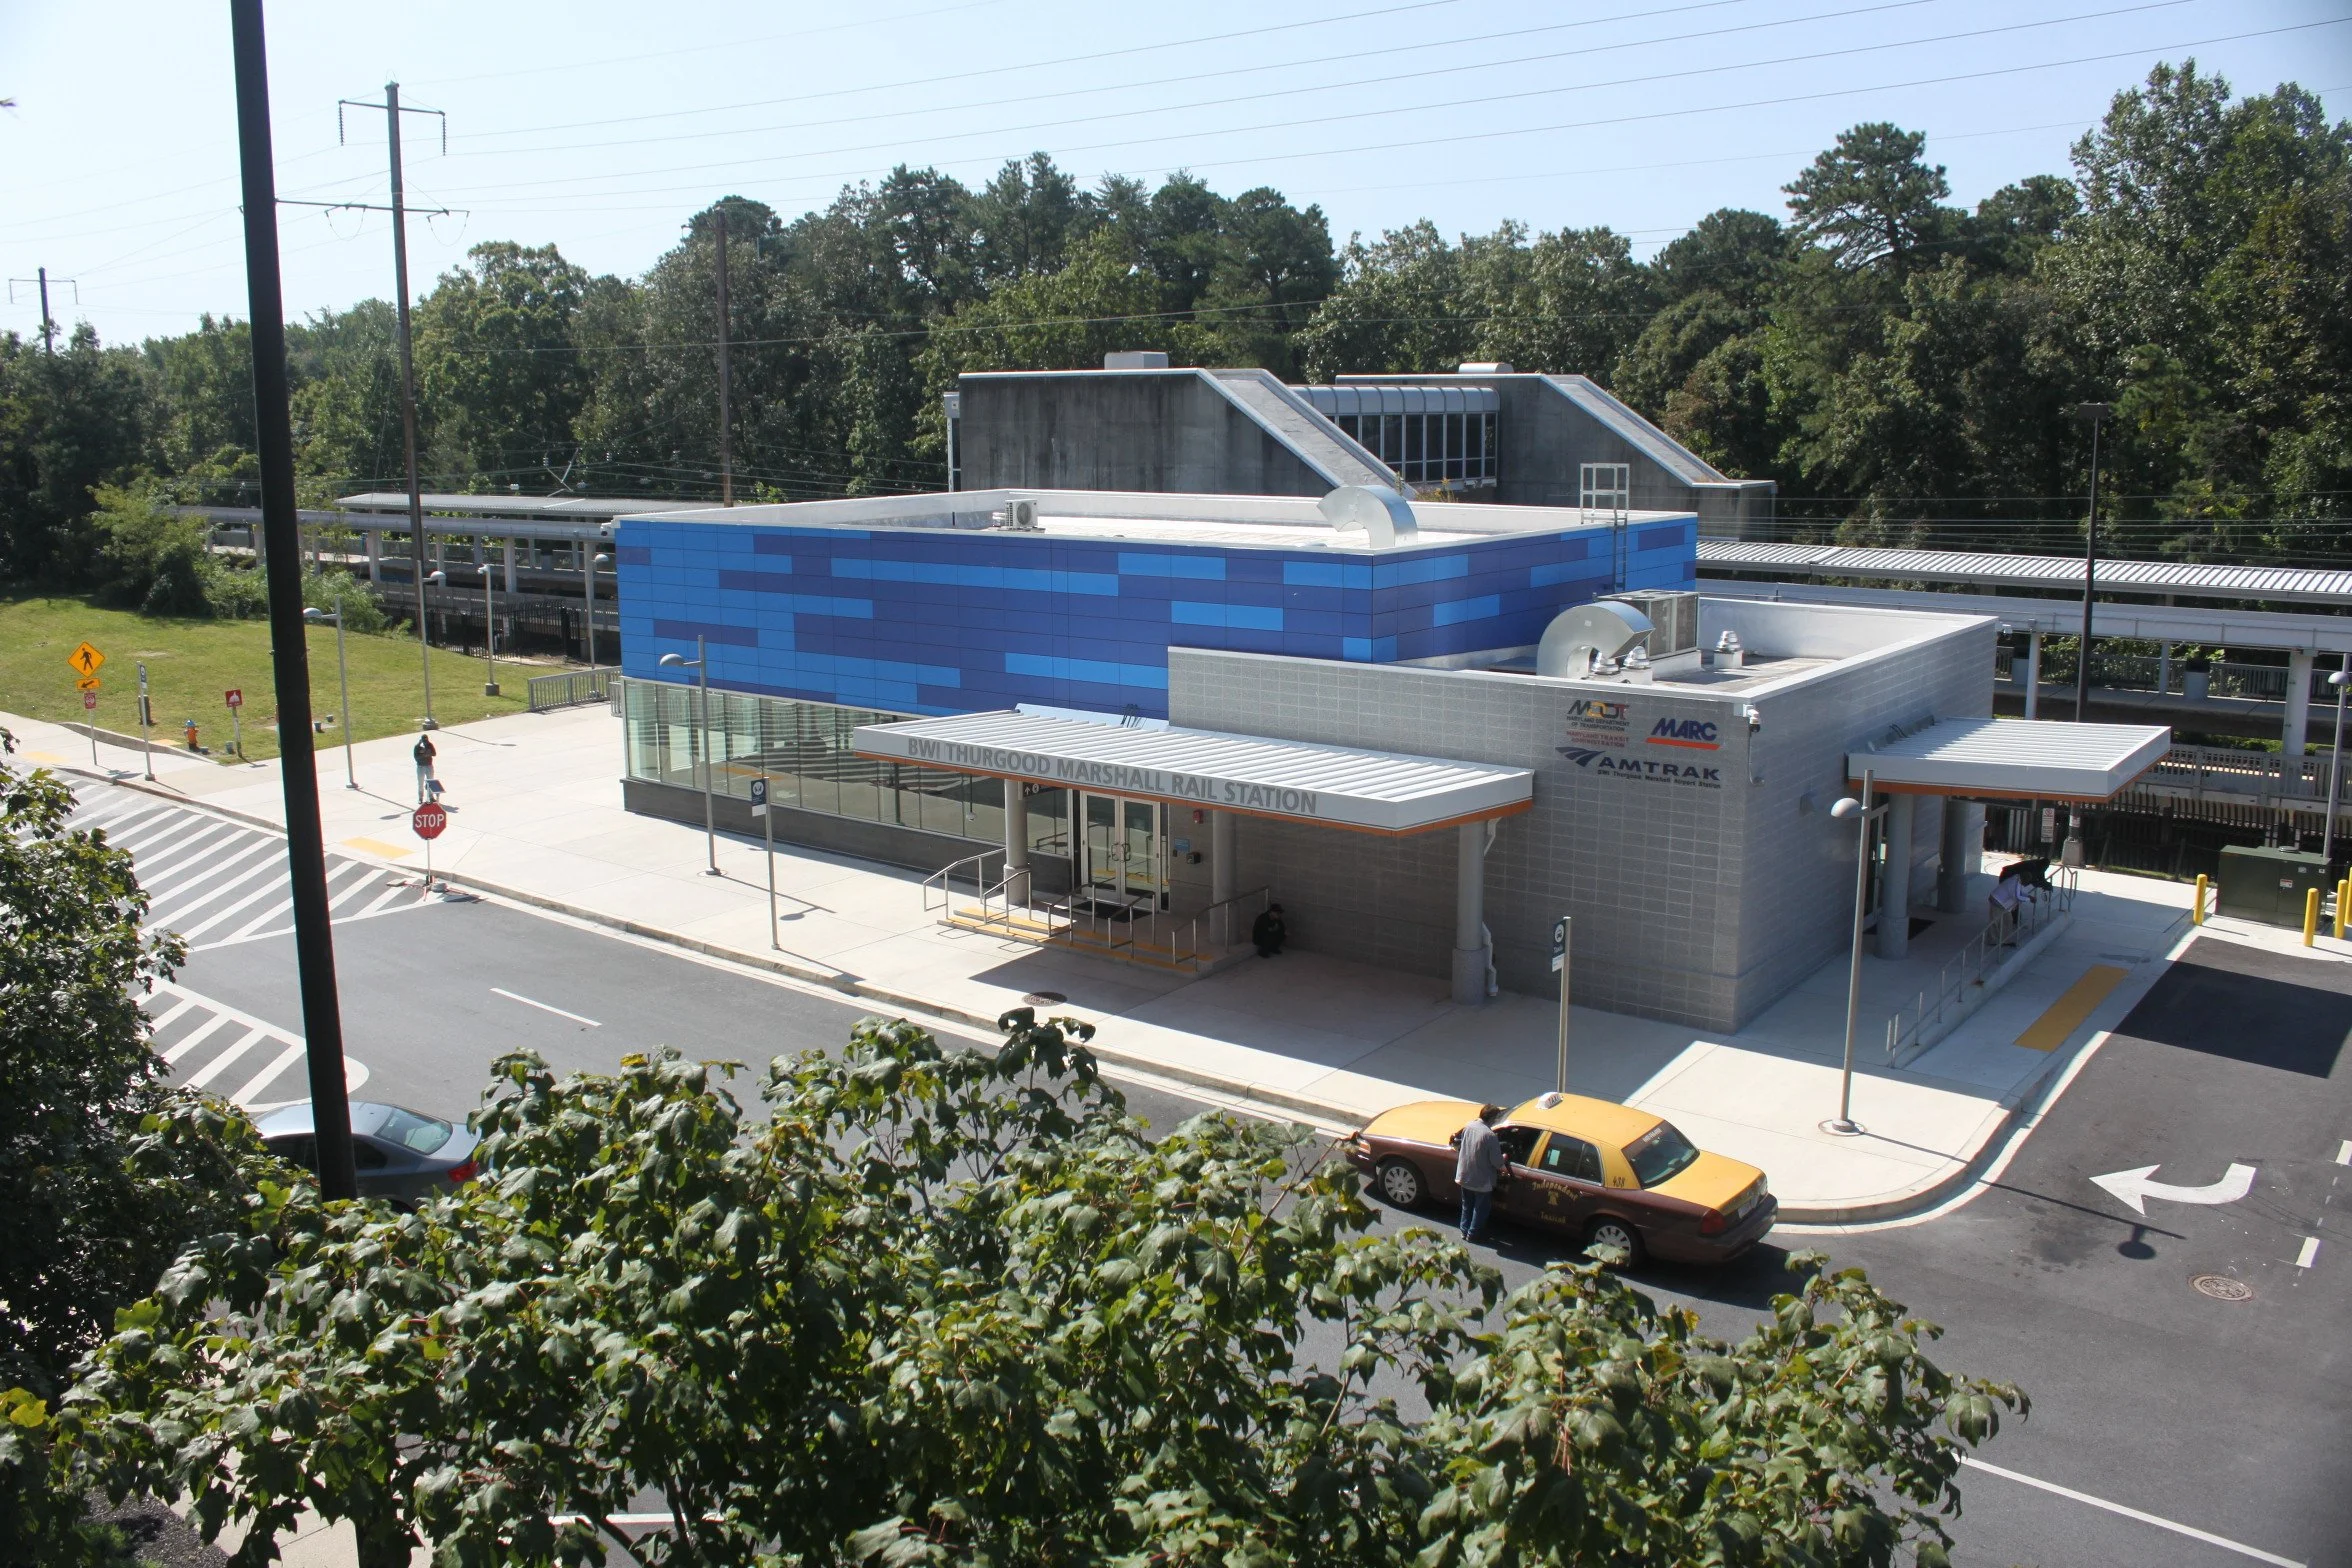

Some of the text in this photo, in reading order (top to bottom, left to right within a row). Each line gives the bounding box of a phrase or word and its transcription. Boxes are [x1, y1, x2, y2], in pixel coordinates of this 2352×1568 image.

[1580, 722, 1625, 731] TRANSPORTATION
[1596, 718, 1630, 726] DEPARTMENT
[1651, 718, 1717, 741] MARC
[908, 738, 1317, 814] BWI THURGOOD MARSHALL RAIL STATION
[1598, 756, 1720, 781] AMTRAK
[1613, 771, 1641, 780] Thurgood
[1645, 775, 1670, 783] Marshall
[1674, 778, 1695, 787] Airport
[1698, 781, 1721, 789] Station
[415, 814, 444, 828] STOP
[1531, 1179, 1579, 1200] Independent
